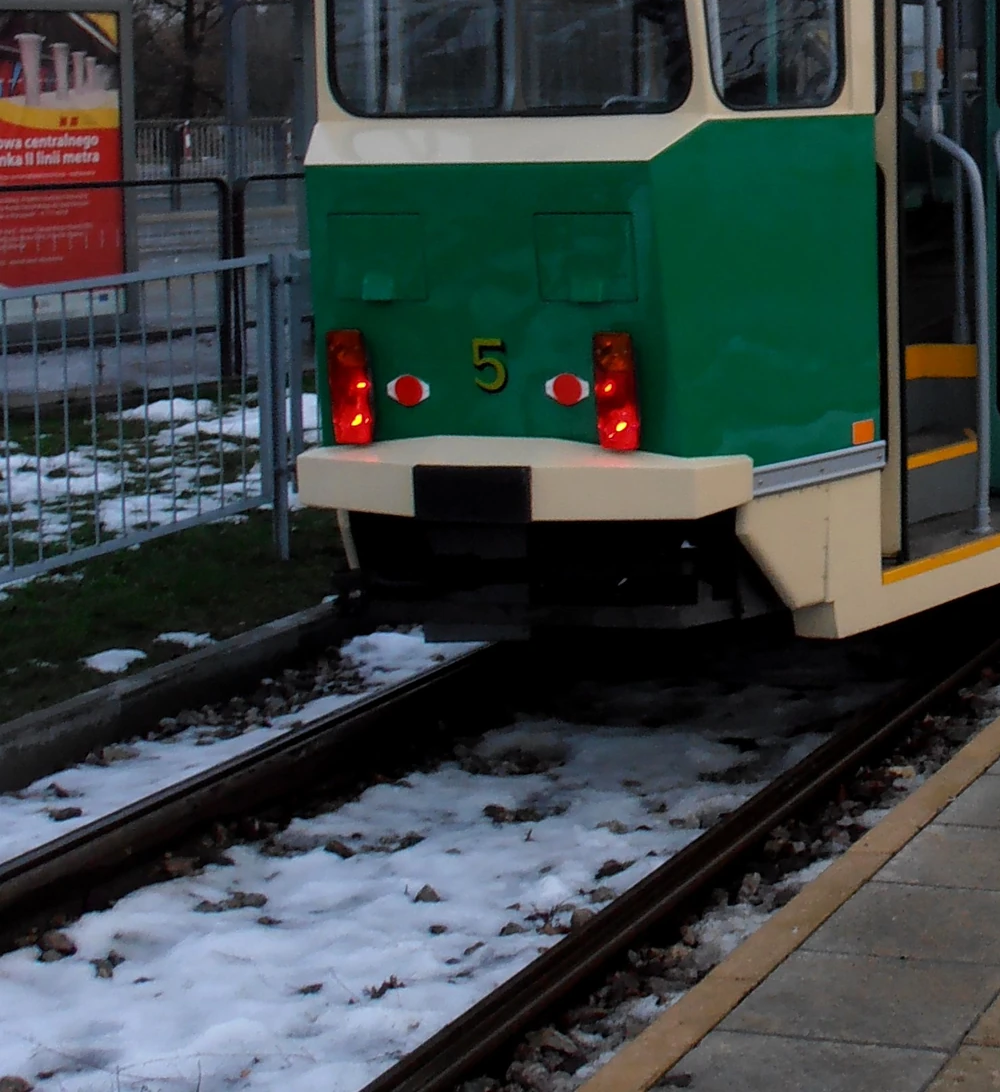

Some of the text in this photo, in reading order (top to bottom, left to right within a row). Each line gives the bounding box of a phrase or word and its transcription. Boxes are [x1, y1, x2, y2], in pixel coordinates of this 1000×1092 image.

[25, 133, 99, 150] centralnego
[36, 150, 60, 165] linii
[63, 152, 100, 163] metra
[471, 338, 507, 393] 5
